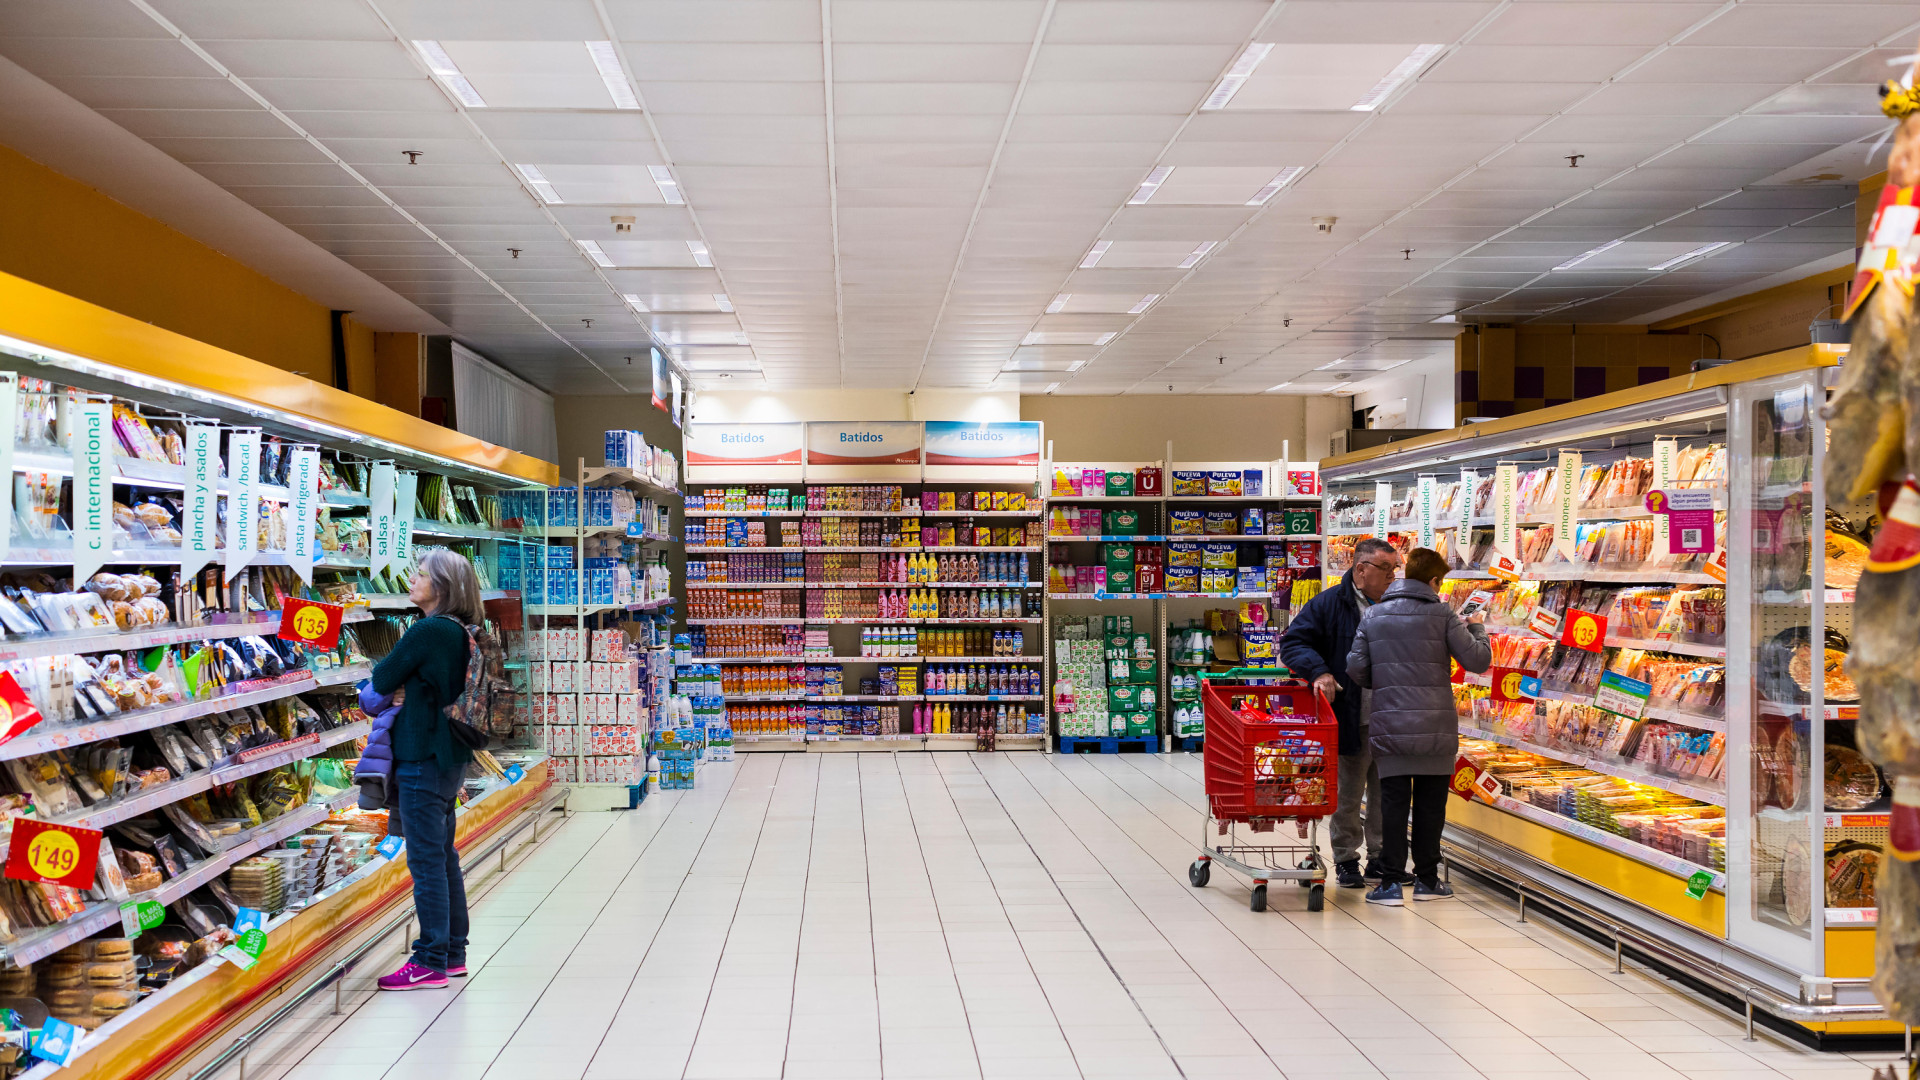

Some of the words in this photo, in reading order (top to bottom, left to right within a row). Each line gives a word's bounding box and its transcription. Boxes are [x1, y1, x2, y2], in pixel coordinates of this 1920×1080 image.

[721, 433, 765, 443] Batidos
[840, 432, 883, 443] Batidos
[960, 431, 1003, 441] Batidos
[194, 432, 208, 481] asados
[238, 441, 250, 487] /bocad.
[85, 411, 100, 531] internacional
[1503, 469, 1511, 492] salud
[1563, 458, 1573, 495] cocidos
[196, 484, 208, 493] y
[296, 457, 310, 522] refrigerada
[191, 496, 206, 551] plancha
[237, 490, 248, 551] sandwich.
[1291, 518, 1310, 532] 62
[1422, 481, 1432, 547] especialidades
[1460, 497, 1471, 545] producto
[1501, 494, 1510, 543] loncheados
[1559, 497, 1571, 540] jamones
[90, 537, 101, 550] c.
[295, 524, 306, 557] pasta
[377, 515, 388, 556] salsas
[396, 521, 408, 559] pizzas
[296, 616, 325, 635] 1'35
[1574, 626, 1594, 643] 1'35
[31, 844, 74, 871] 1'49
[139, 911, 147, 920] EL
[146, 903, 161, 916] MÁS
[142, 910, 164, 926] BARATO
[244, 945, 252, 953] EL
[246, 931, 257, 944] MÁS
[251, 931, 264, 954] BARATO
